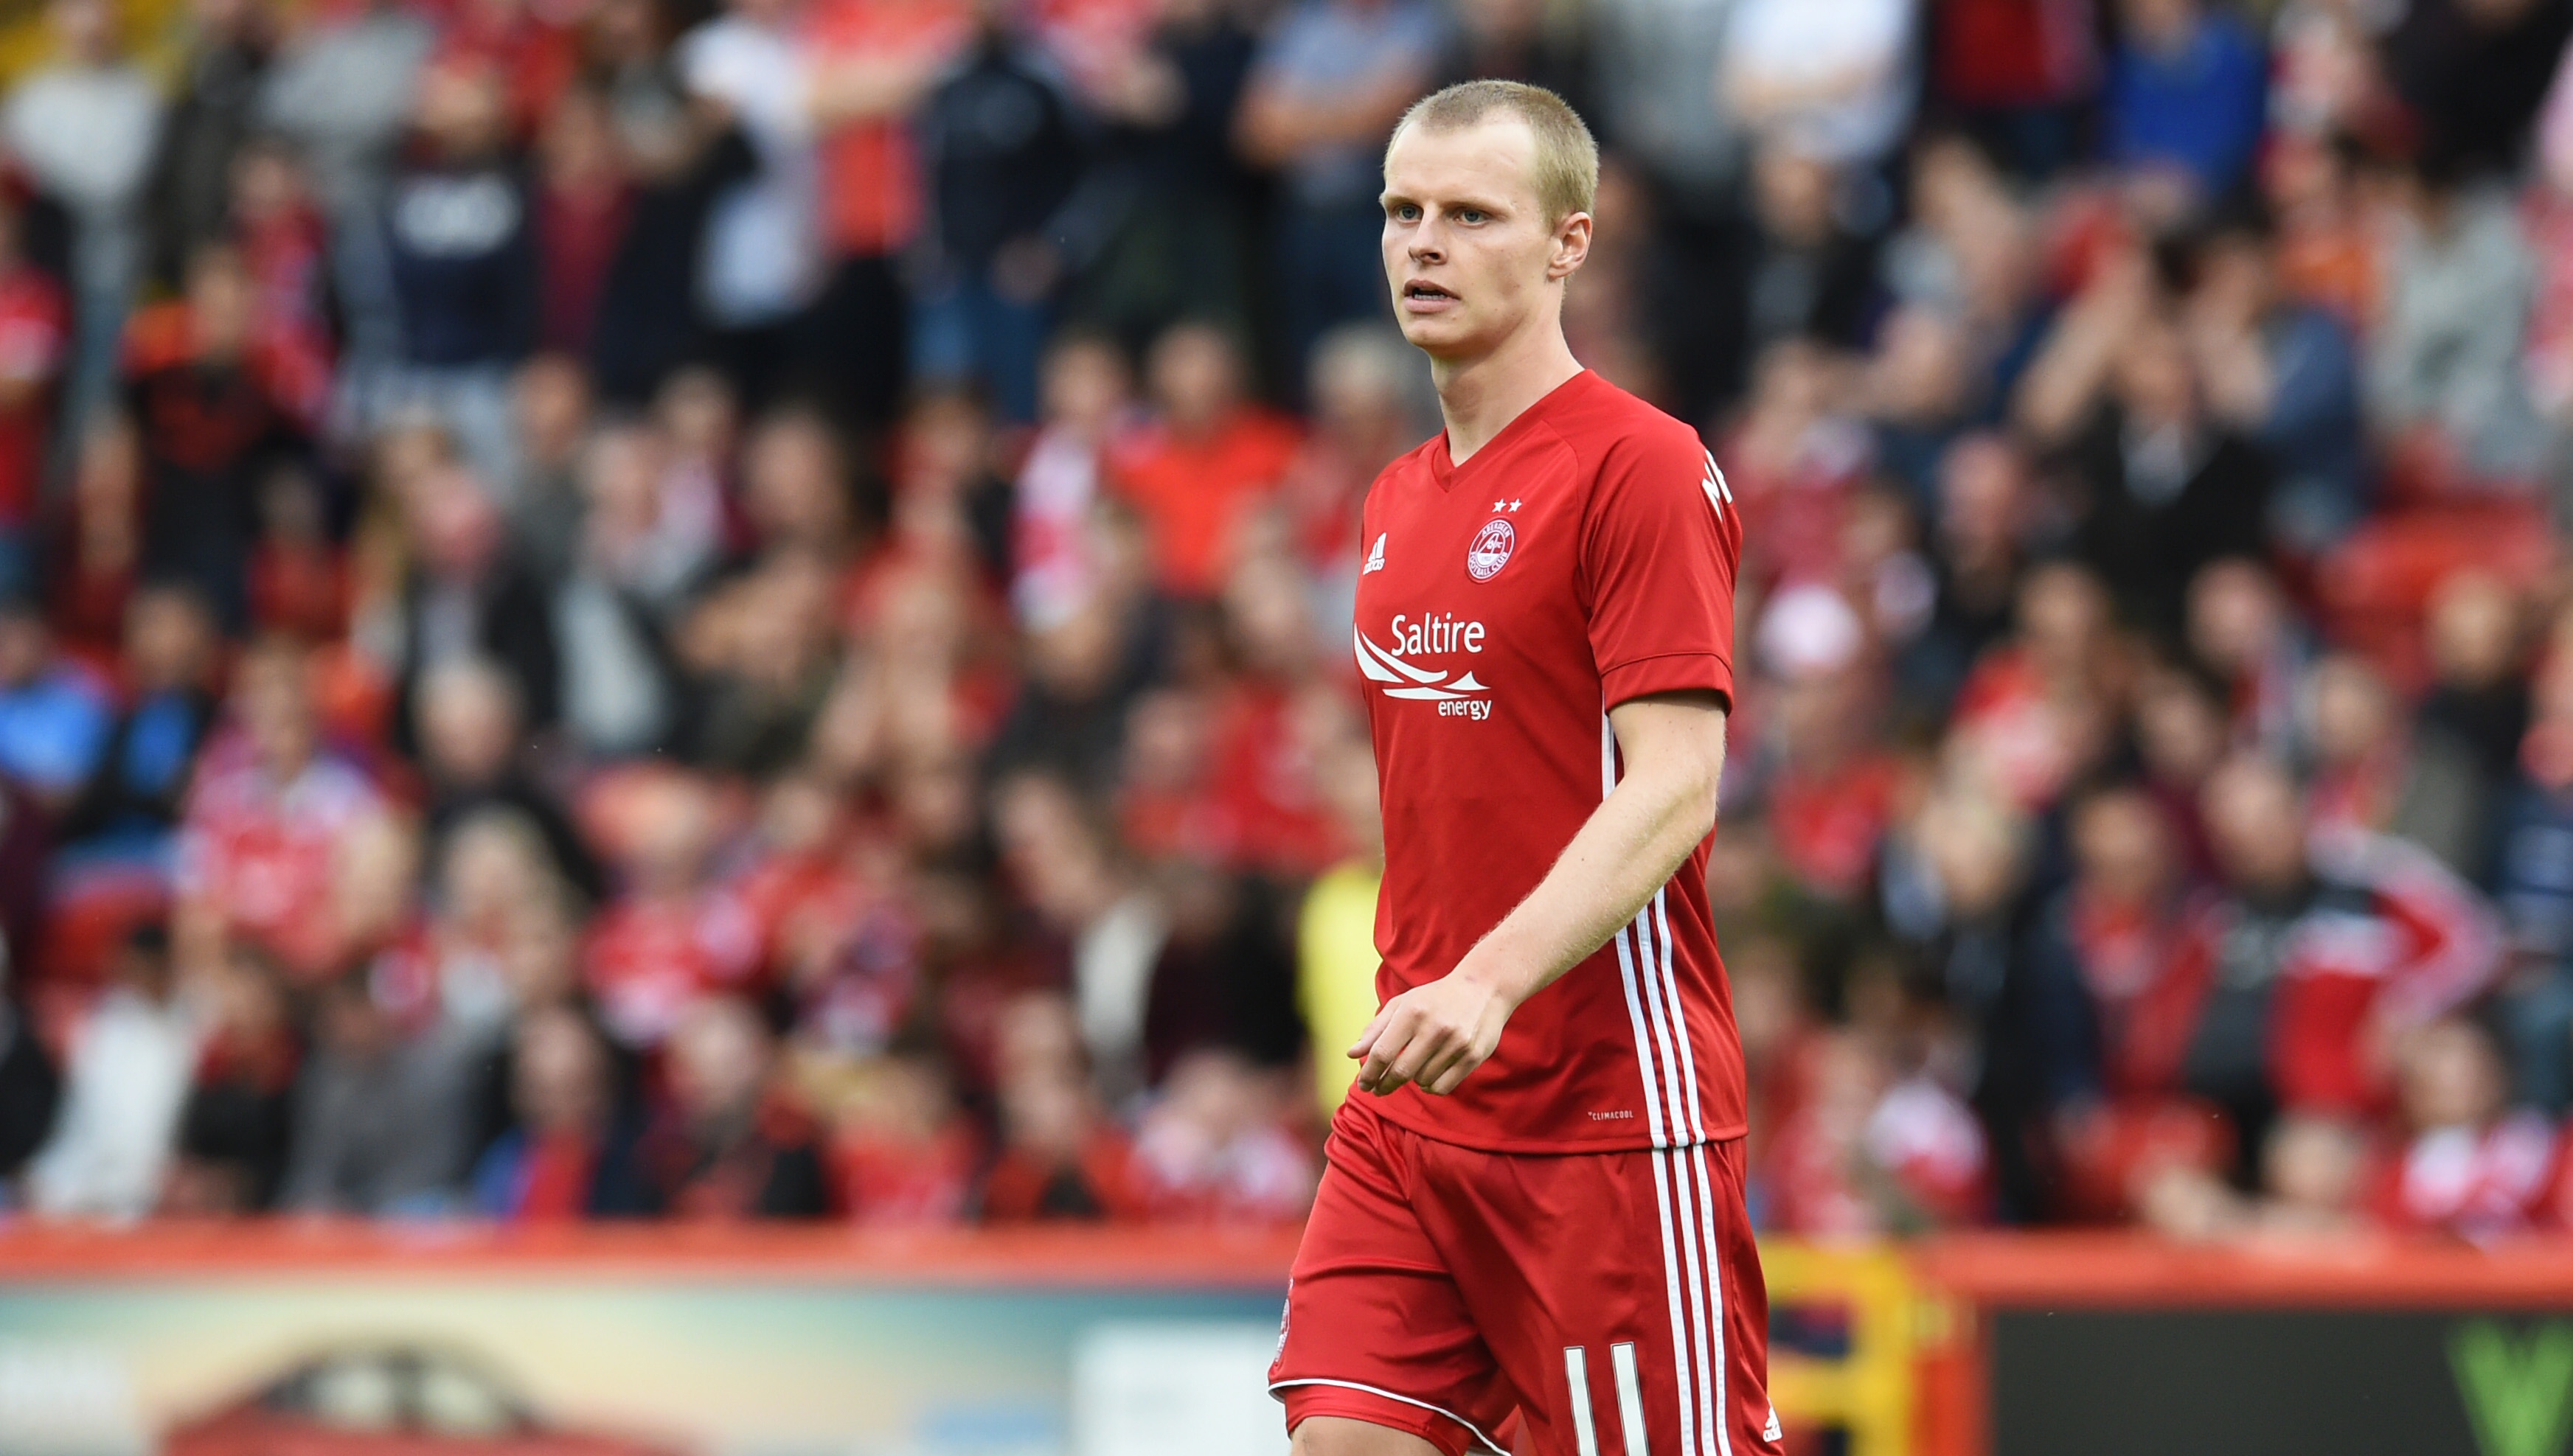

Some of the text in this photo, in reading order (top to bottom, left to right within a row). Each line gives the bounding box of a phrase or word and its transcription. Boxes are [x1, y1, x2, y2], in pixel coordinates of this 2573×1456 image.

[1391, 612, 1485, 657] Saltire
[1438, 700, 1492, 720] energy
[1592, 1110, 1634, 1121] CLIMACOOL
